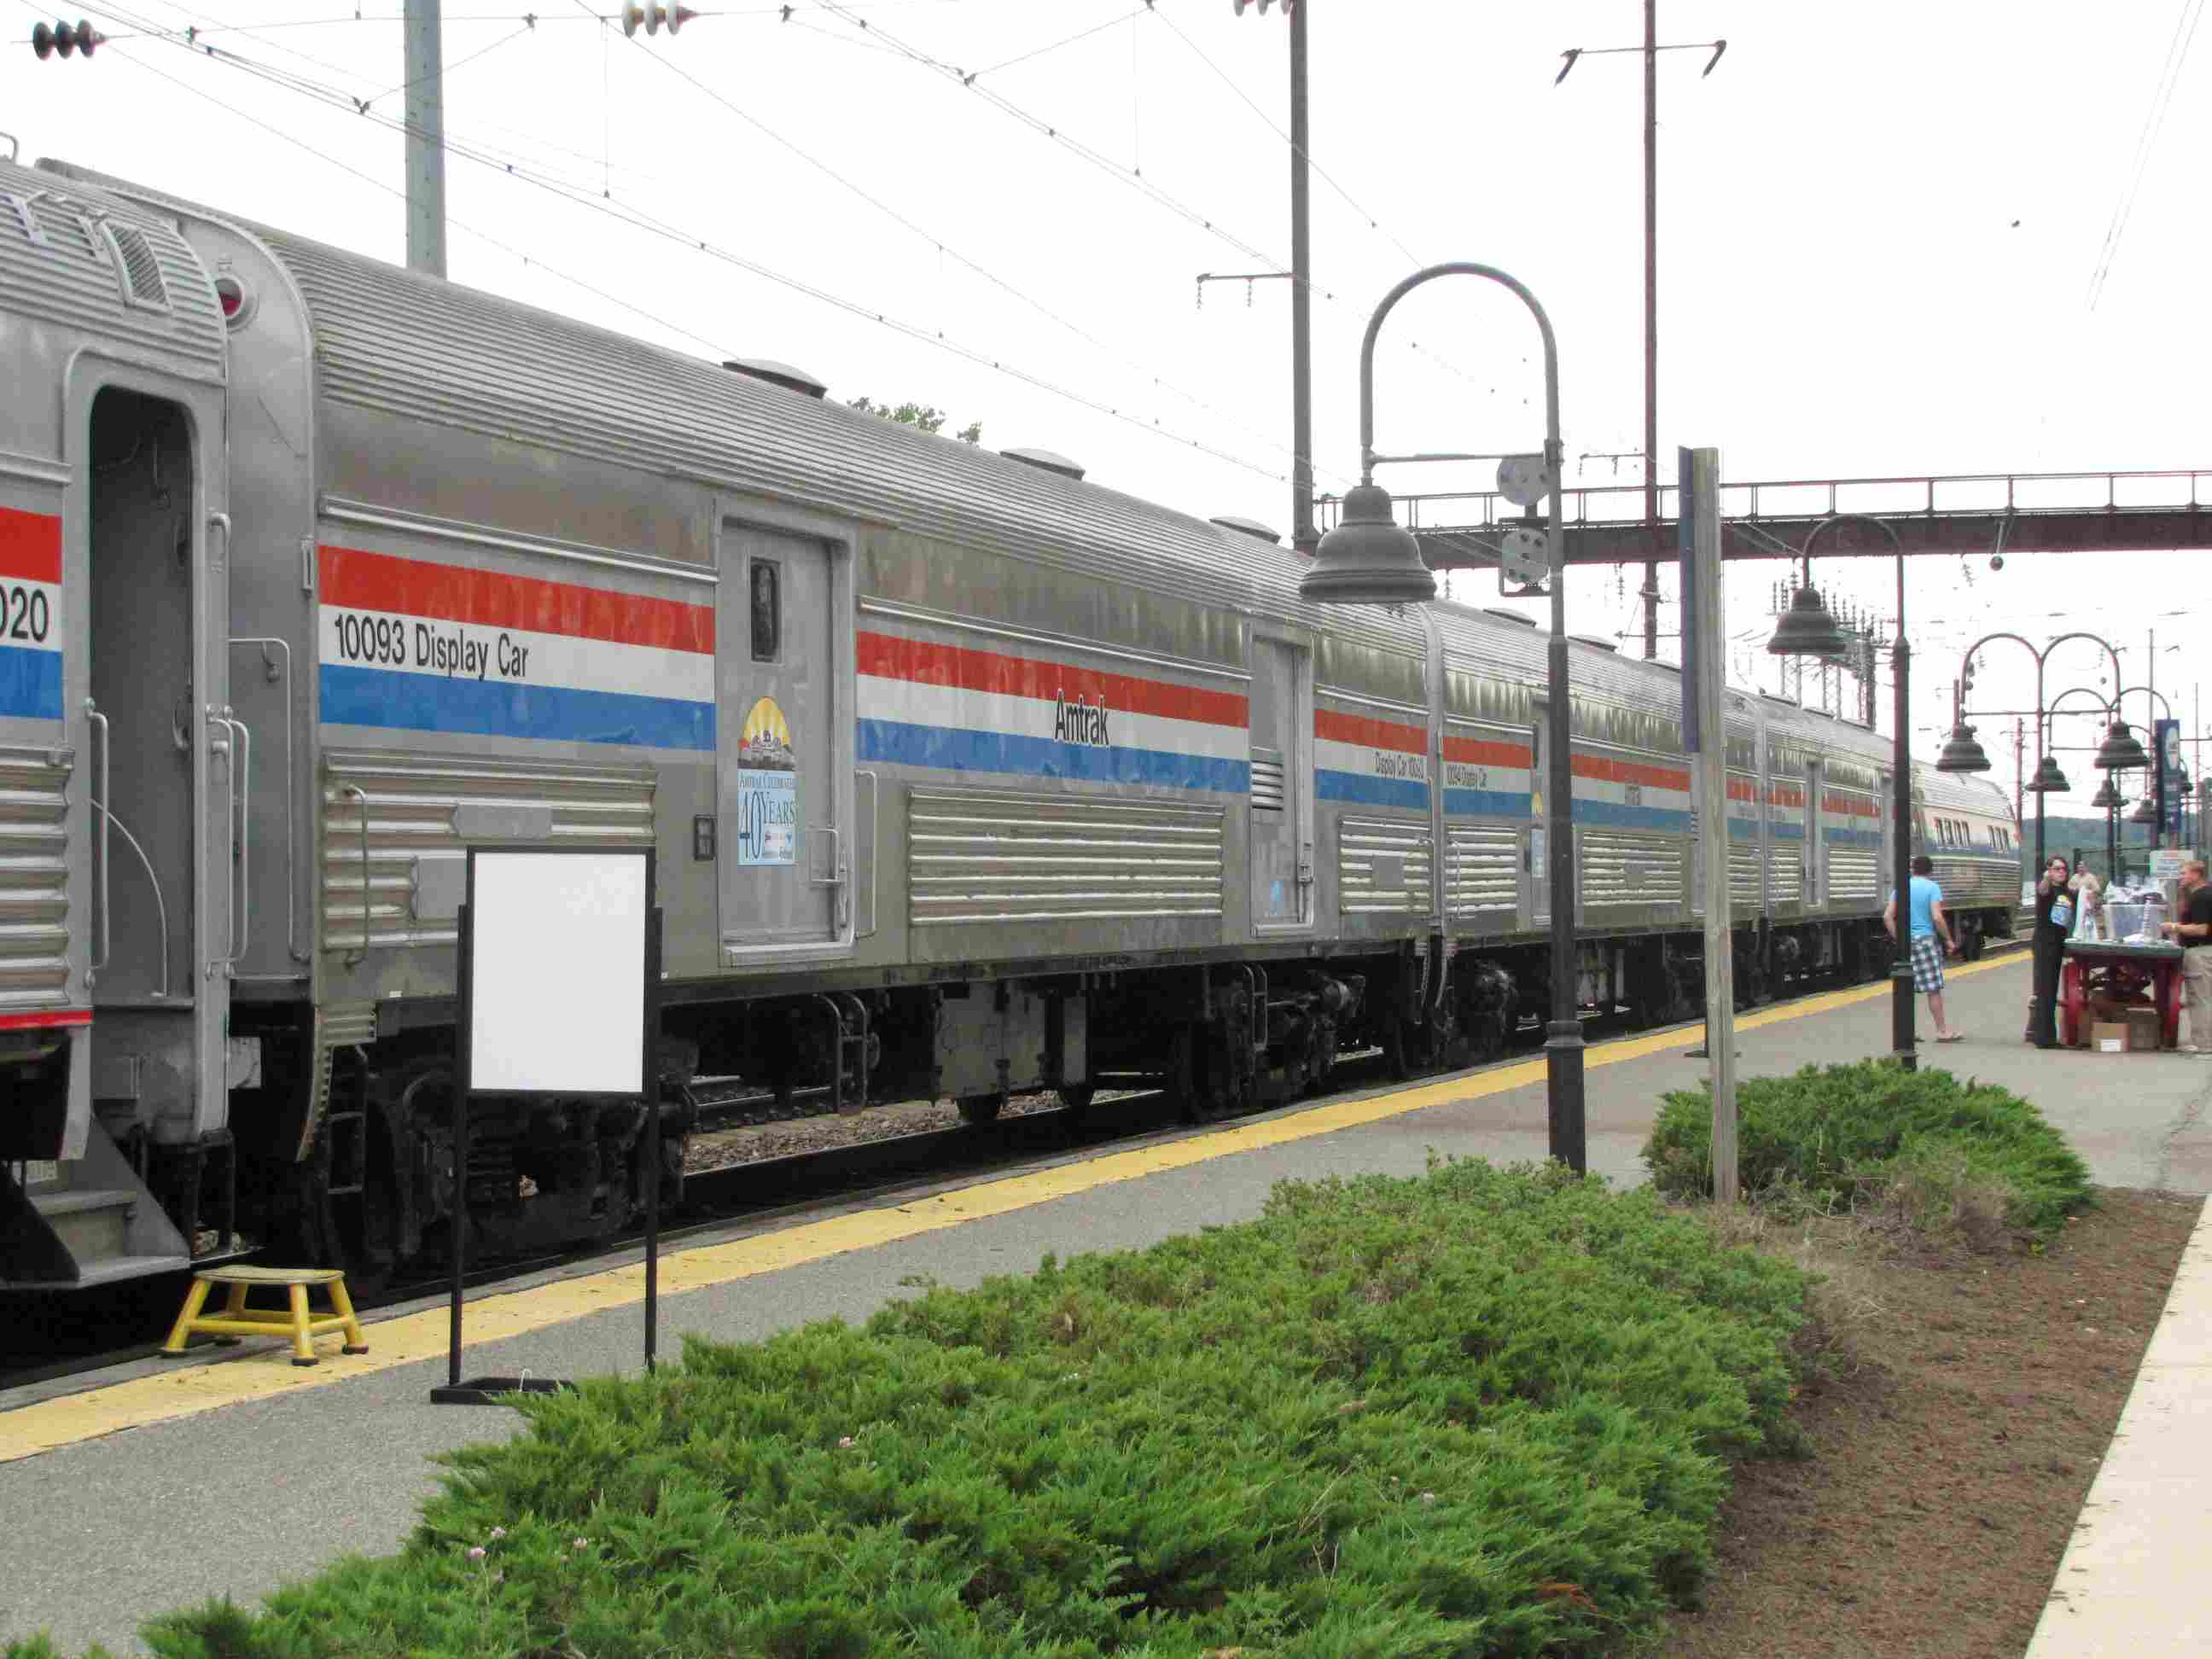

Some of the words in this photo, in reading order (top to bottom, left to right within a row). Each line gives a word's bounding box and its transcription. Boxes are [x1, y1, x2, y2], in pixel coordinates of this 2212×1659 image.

[335, 614, 406, 666] 10093
[416, 623, 488, 683] Display
[498, 632, 528, 677] Car
[1055, 690, 1109, 745] Amtrak
[739, 790, 761, 859] 40
